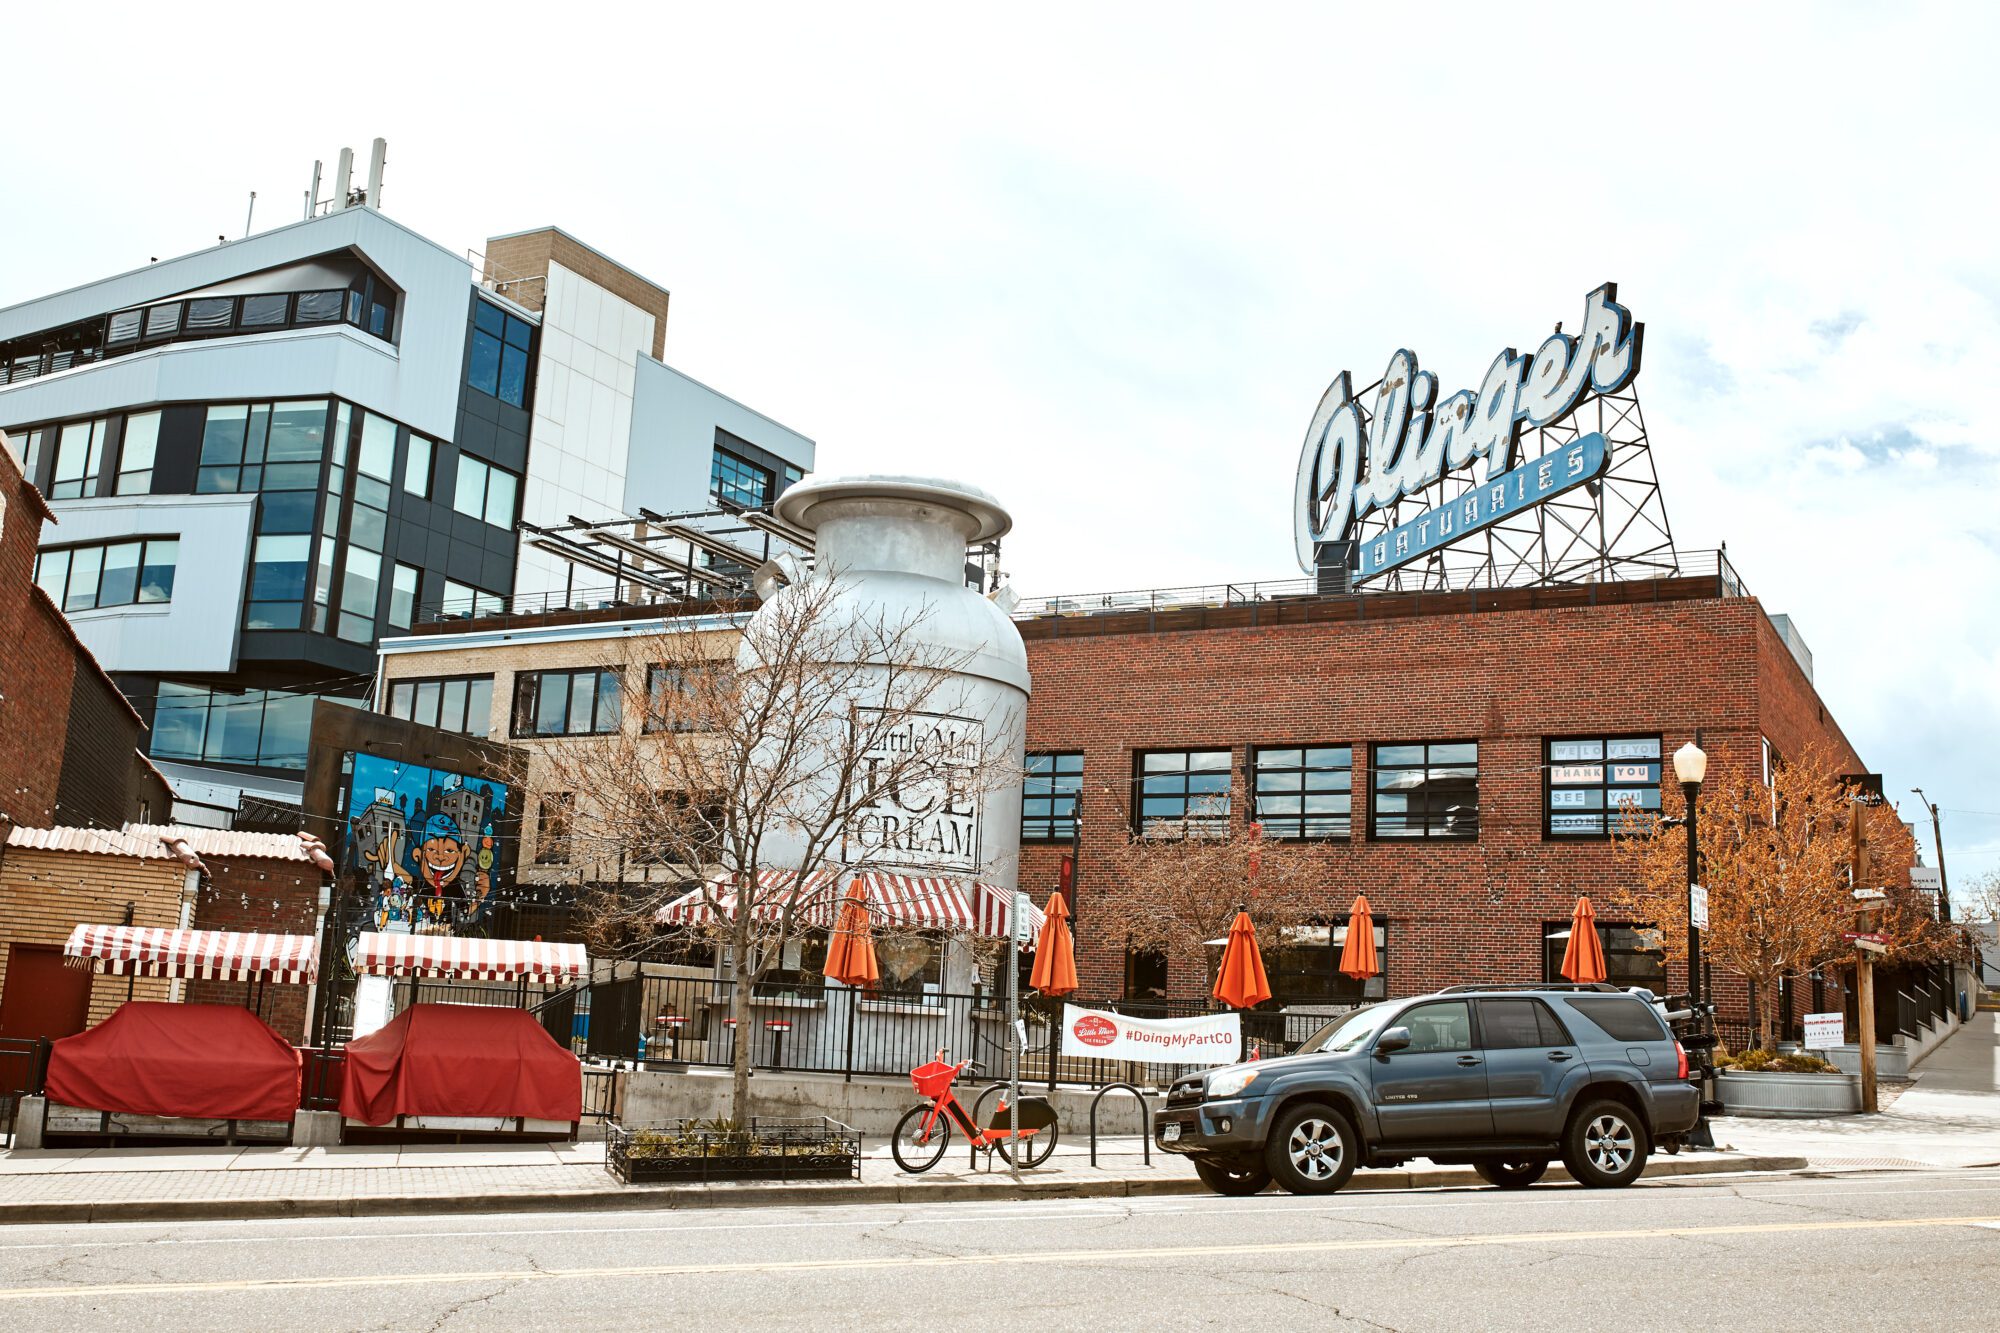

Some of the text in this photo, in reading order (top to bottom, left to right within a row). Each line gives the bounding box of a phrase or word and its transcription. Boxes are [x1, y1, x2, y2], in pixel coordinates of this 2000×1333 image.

[867, 722, 976, 760] Little Man
[1557, 747, 1578, 755] WE
[1632, 744, 1658, 754] YOU
[1554, 767, 1646, 777] THANK YOU
[863, 756, 979, 818] ICE
[1553, 792, 1641, 802] SEE YOU
[1553, 817, 1595, 828] SOON
[857, 814, 974, 857] CREAM
[1077, 1026, 1115, 1037] Little Man
[1126, 1030, 1232, 1048] #DoingMyPartCO
